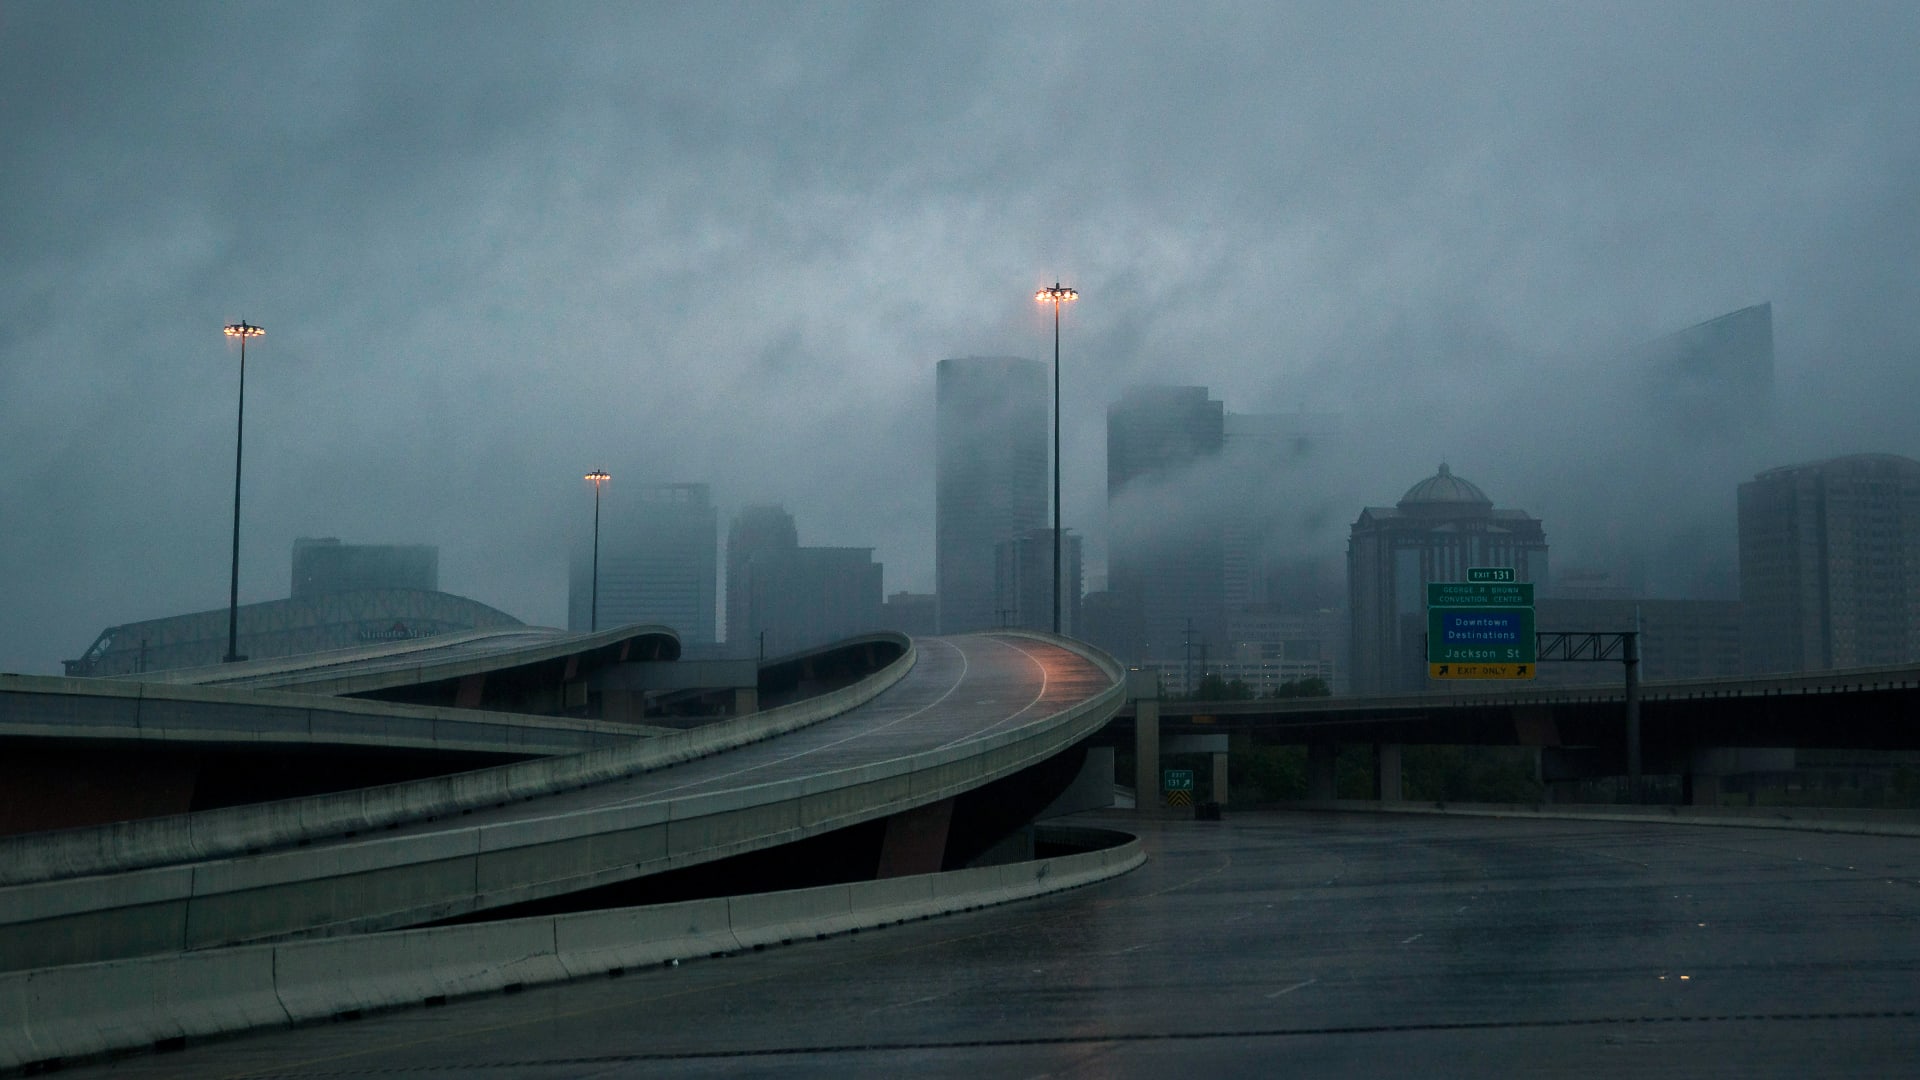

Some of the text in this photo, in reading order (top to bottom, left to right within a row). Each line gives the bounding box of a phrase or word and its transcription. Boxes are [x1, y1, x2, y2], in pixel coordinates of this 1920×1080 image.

[1474, 570, 1509, 580] EXIT 131
[1455, 618, 1508, 626] Downtown
[1448, 630, 1516, 639] Destinations
[1445, 649, 1520, 658] Jackson St
